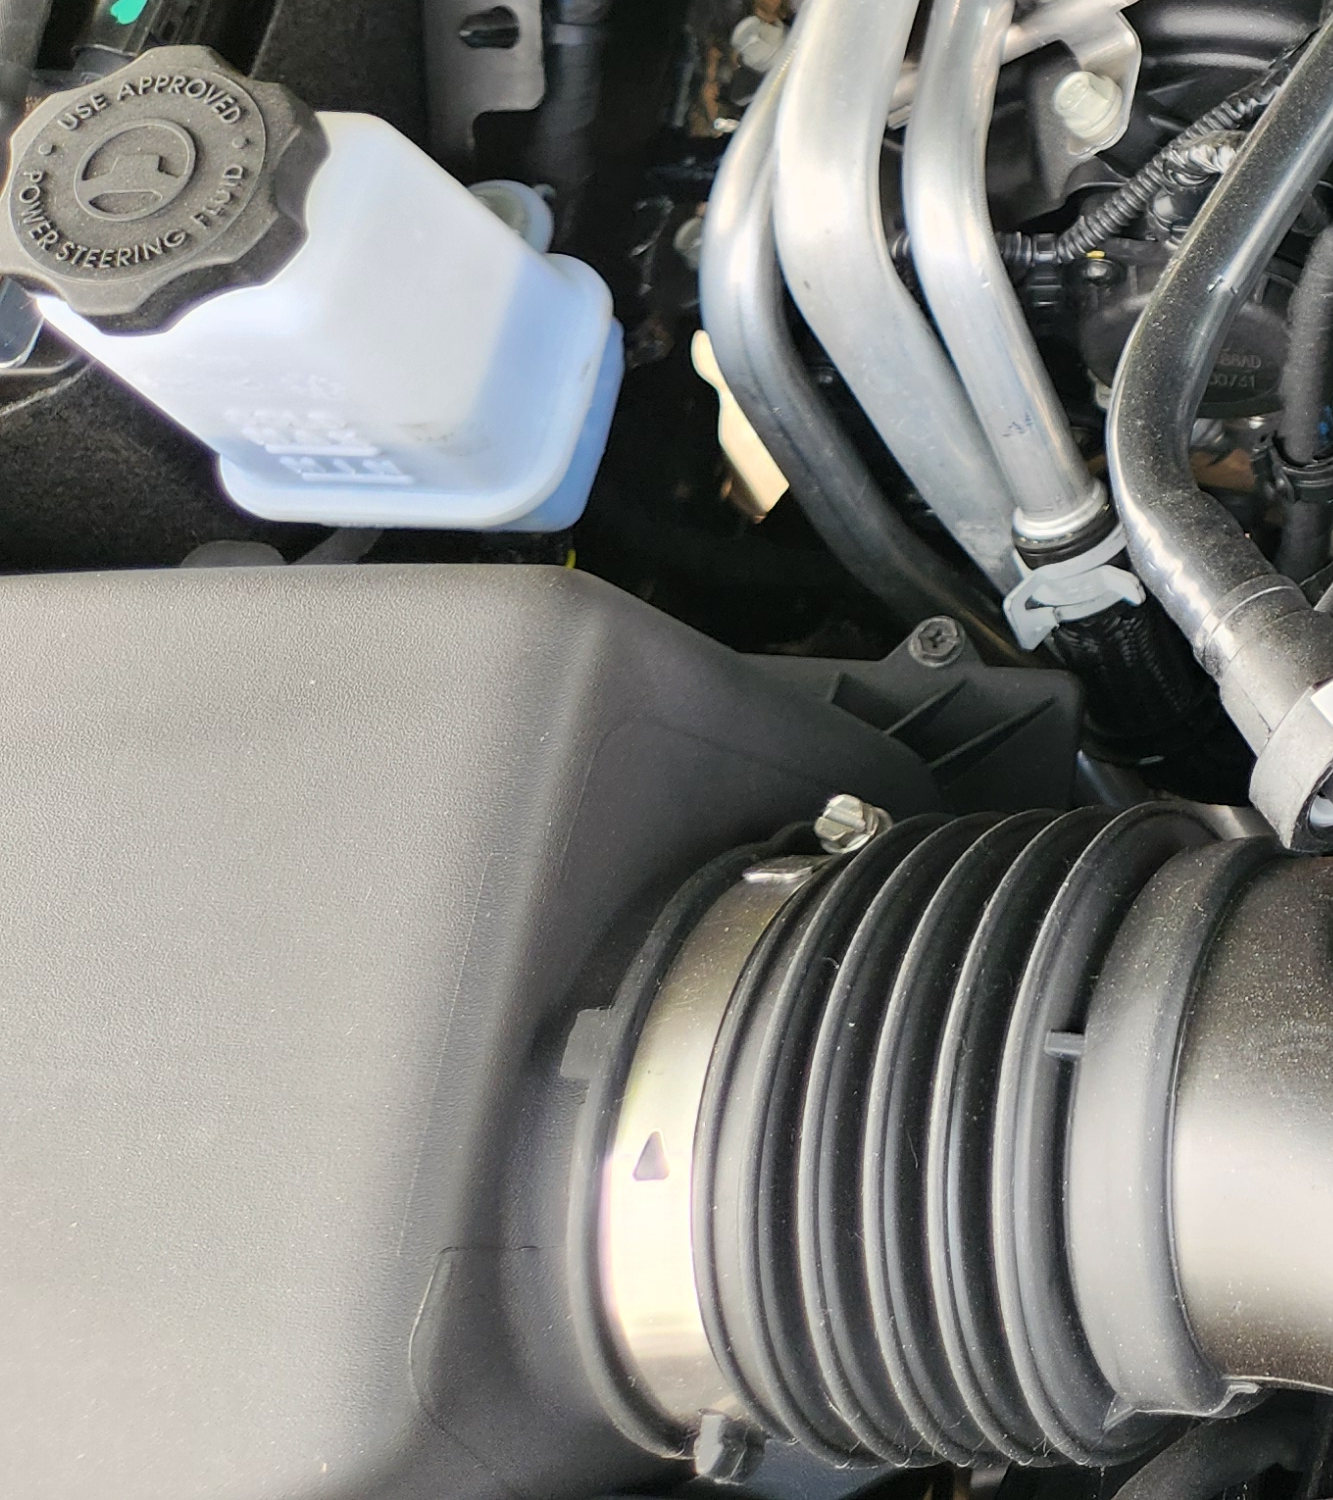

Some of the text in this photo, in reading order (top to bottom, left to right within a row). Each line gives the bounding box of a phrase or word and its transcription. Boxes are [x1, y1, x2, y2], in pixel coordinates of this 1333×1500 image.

[57, 75, 243, 131] USE APPROVED
[19, 164, 245, 269] POWER STEERING FLUID
